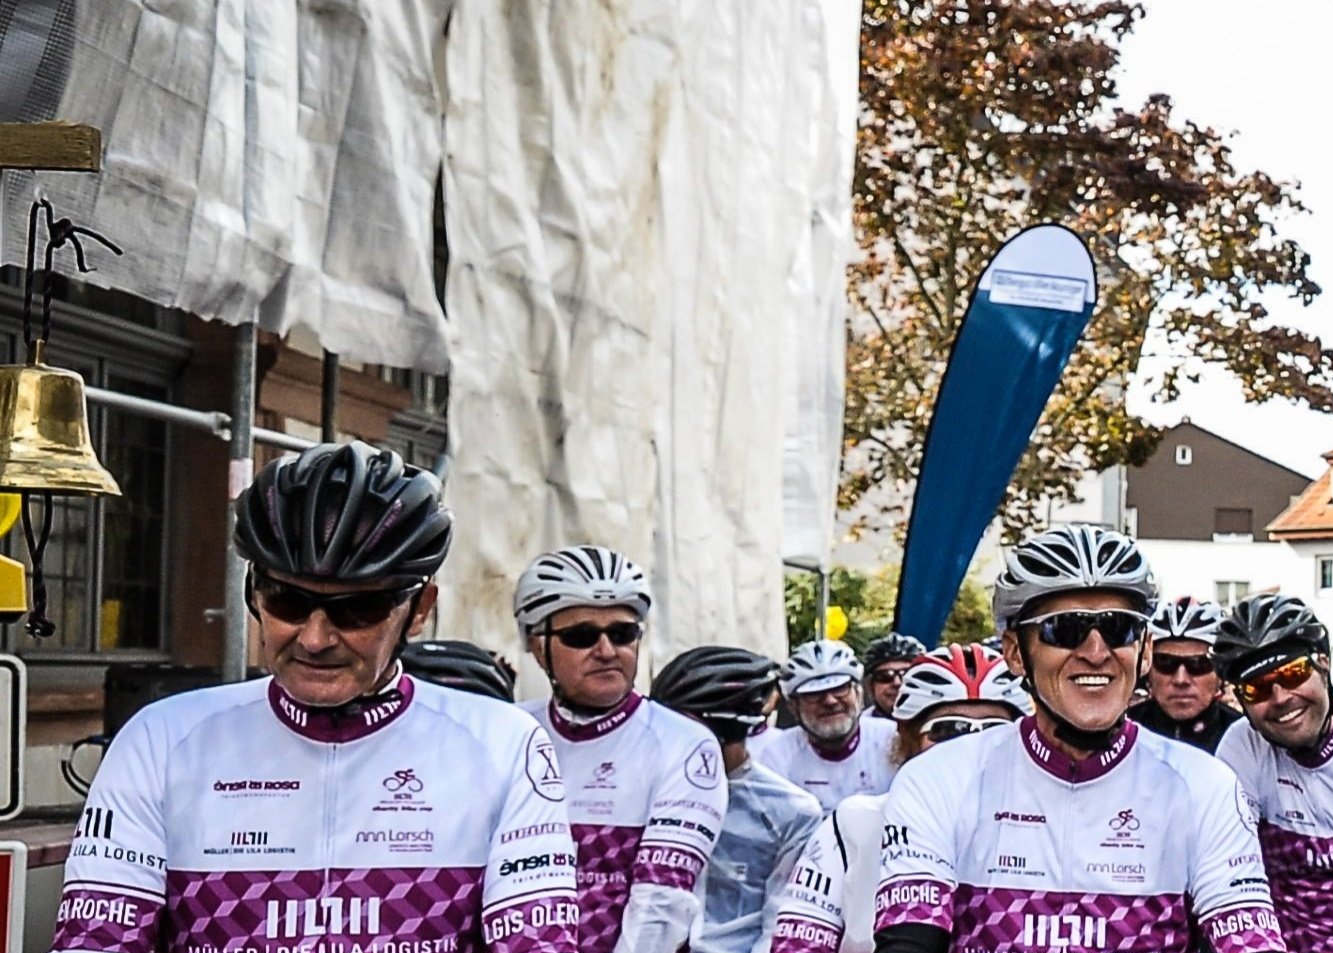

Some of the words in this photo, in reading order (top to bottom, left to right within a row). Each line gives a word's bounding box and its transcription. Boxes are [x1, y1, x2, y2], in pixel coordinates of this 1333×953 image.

[388, 828, 434, 842] Lorsch
[104, 846, 168, 871] LOGIST
[1110, 862, 1146, 875] Lorsch
[893, 886, 941, 906] ROCHE
[72, 897, 139, 928] ROCHE
[484, 911, 525, 945] LGIS
[531, 902, 580, 927] OLEK
